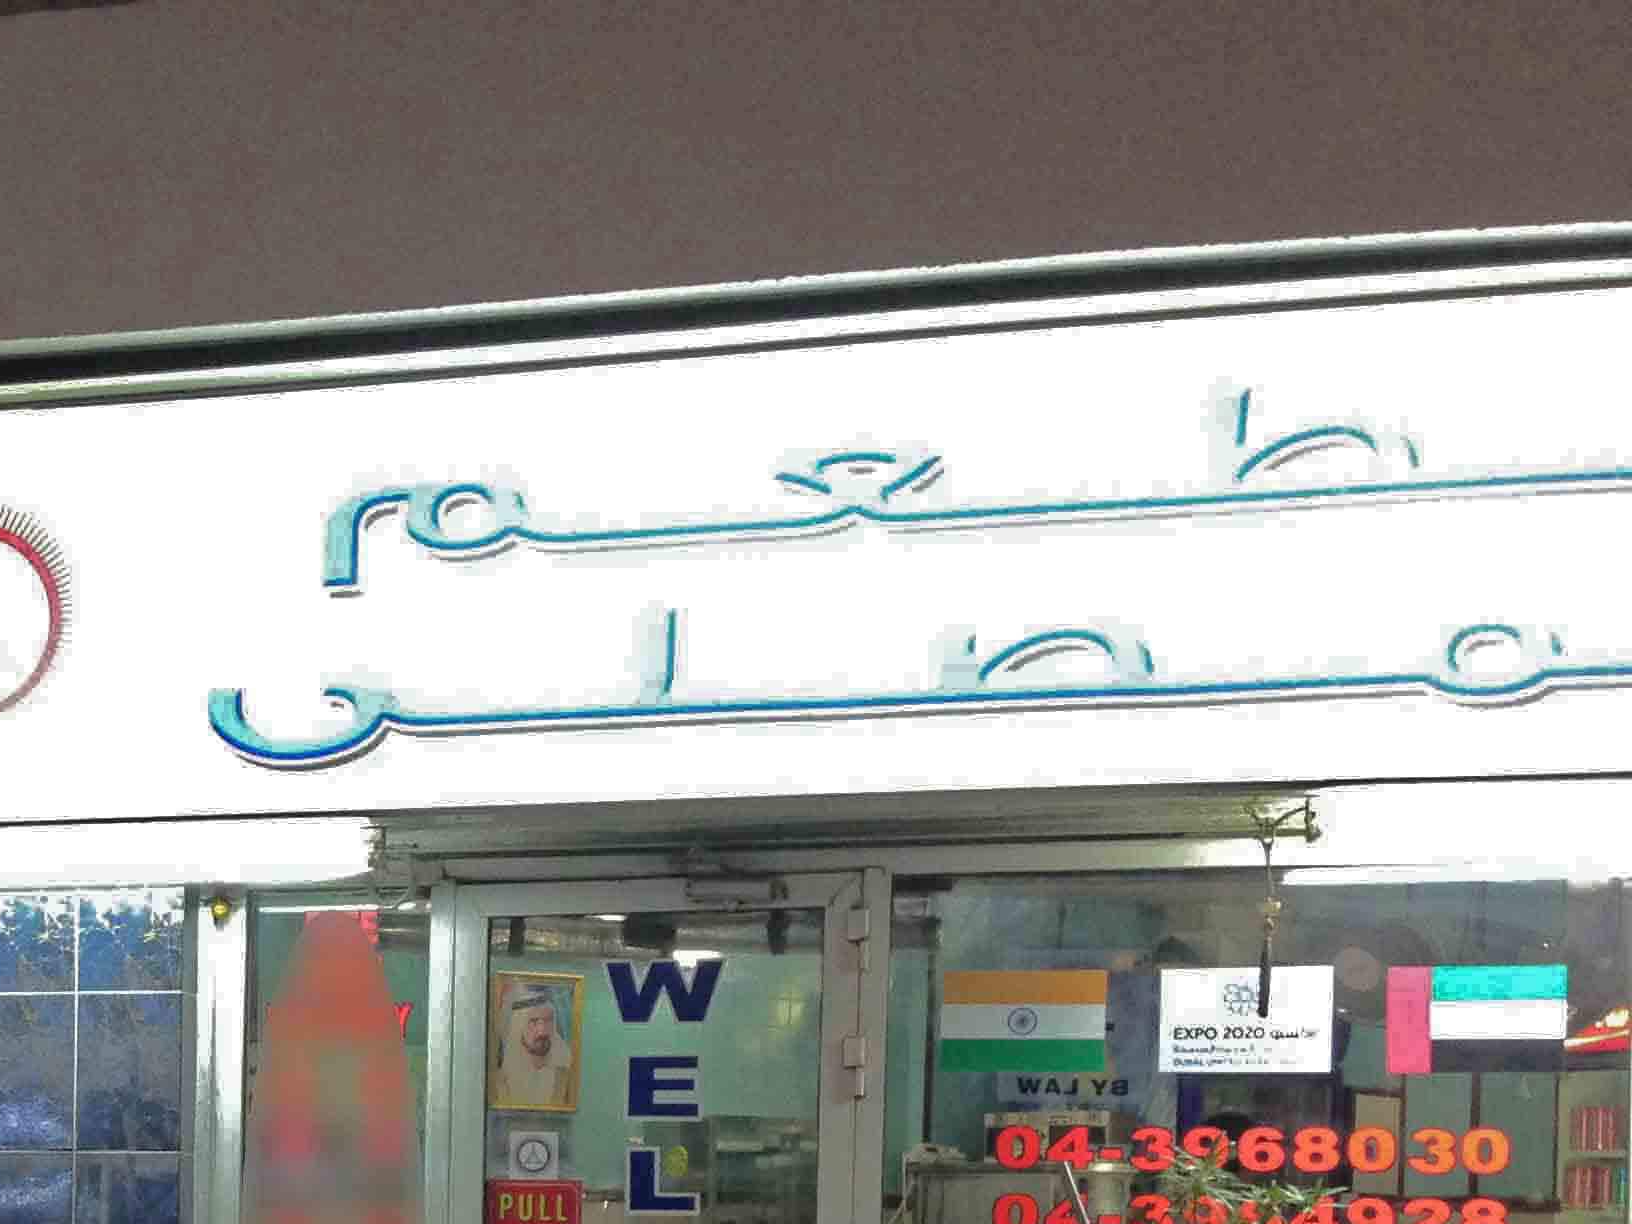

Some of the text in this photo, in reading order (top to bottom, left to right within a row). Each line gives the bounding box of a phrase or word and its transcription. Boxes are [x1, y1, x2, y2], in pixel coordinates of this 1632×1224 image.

[323, 386, 1632, 594] طعم
[1172, 1025, 1266, 1041] EXPO 2020
[994, 1124, 1512, 1176] 04-3968030
[497, 1192, 569, 1222] PULL
